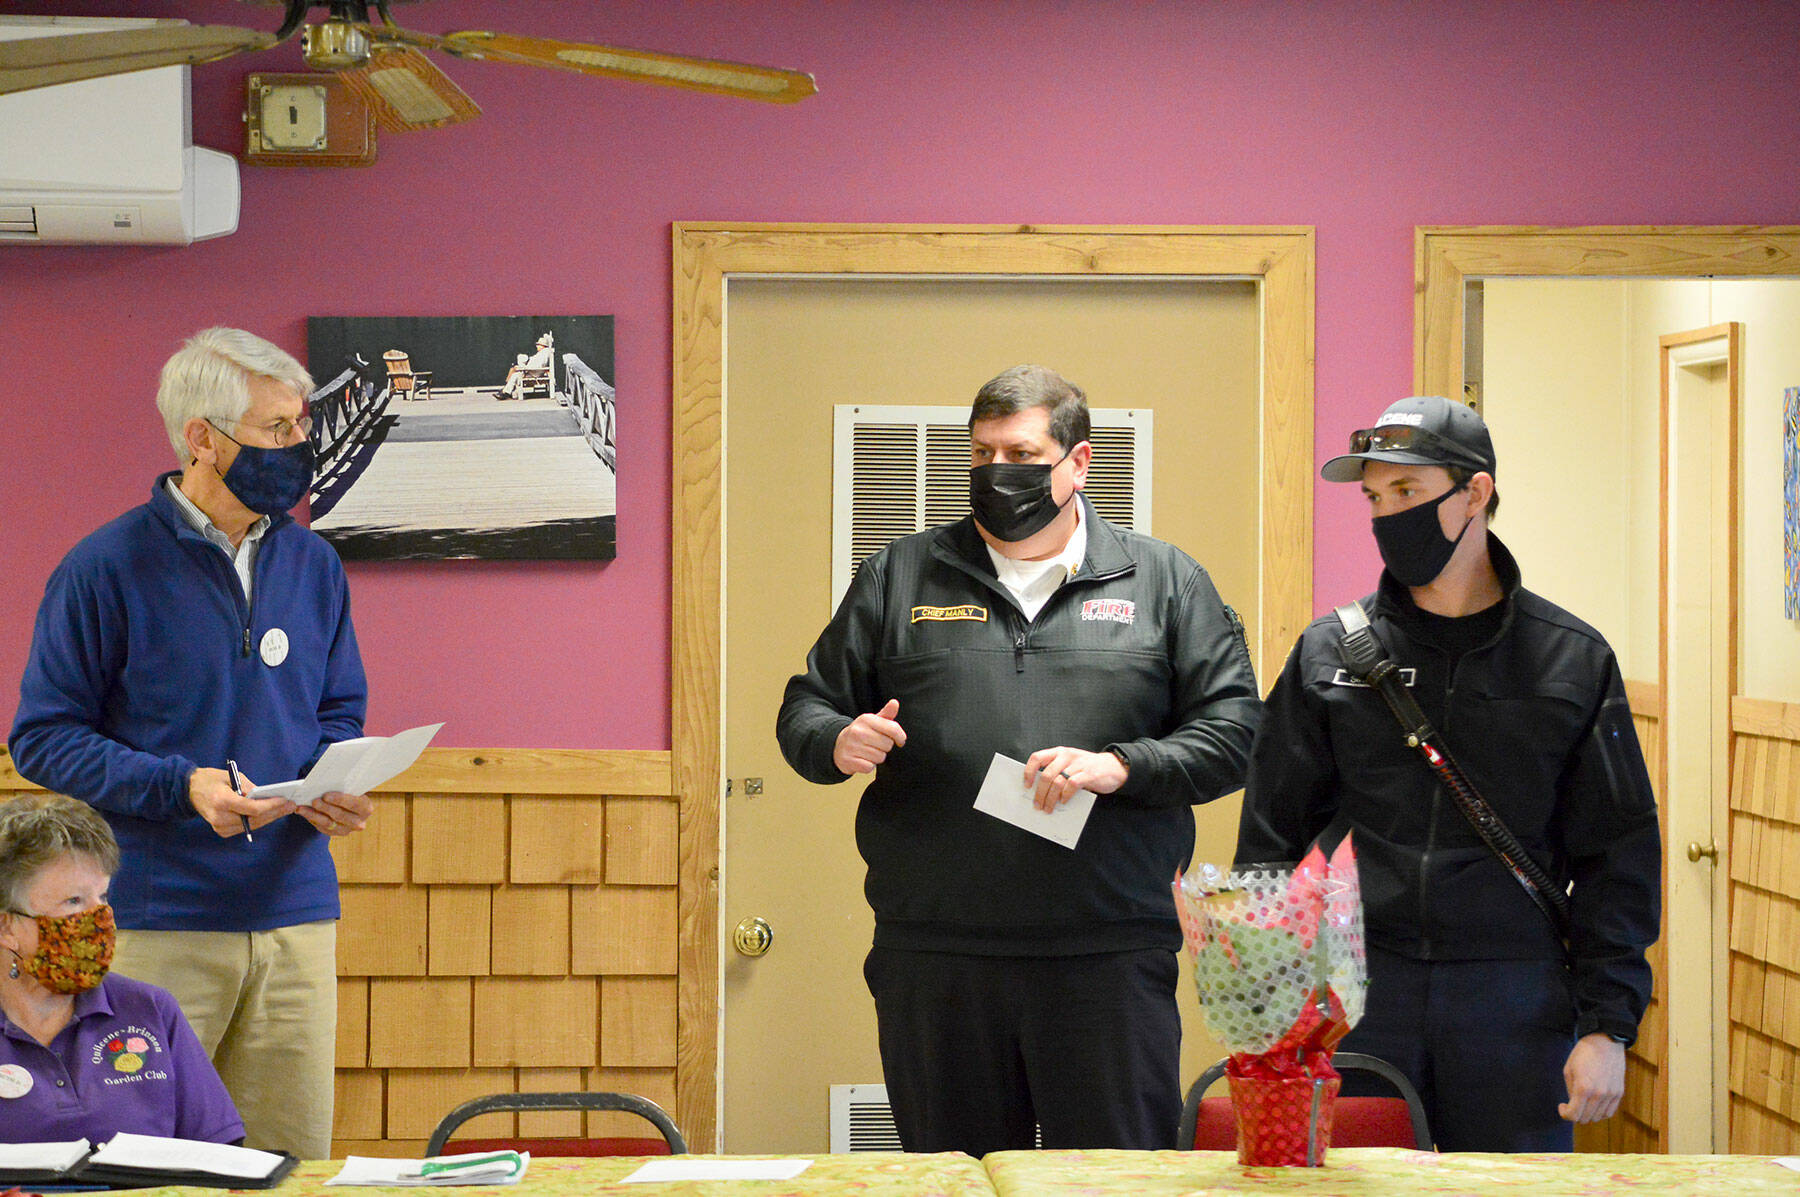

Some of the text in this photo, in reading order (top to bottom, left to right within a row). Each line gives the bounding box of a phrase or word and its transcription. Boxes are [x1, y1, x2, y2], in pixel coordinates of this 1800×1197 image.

[921, 608, 974, 617] CHIEF MANLY
[1082, 614, 1134, 625] DEPARTMENT
[104, 1070, 167, 1085] Garden Club
